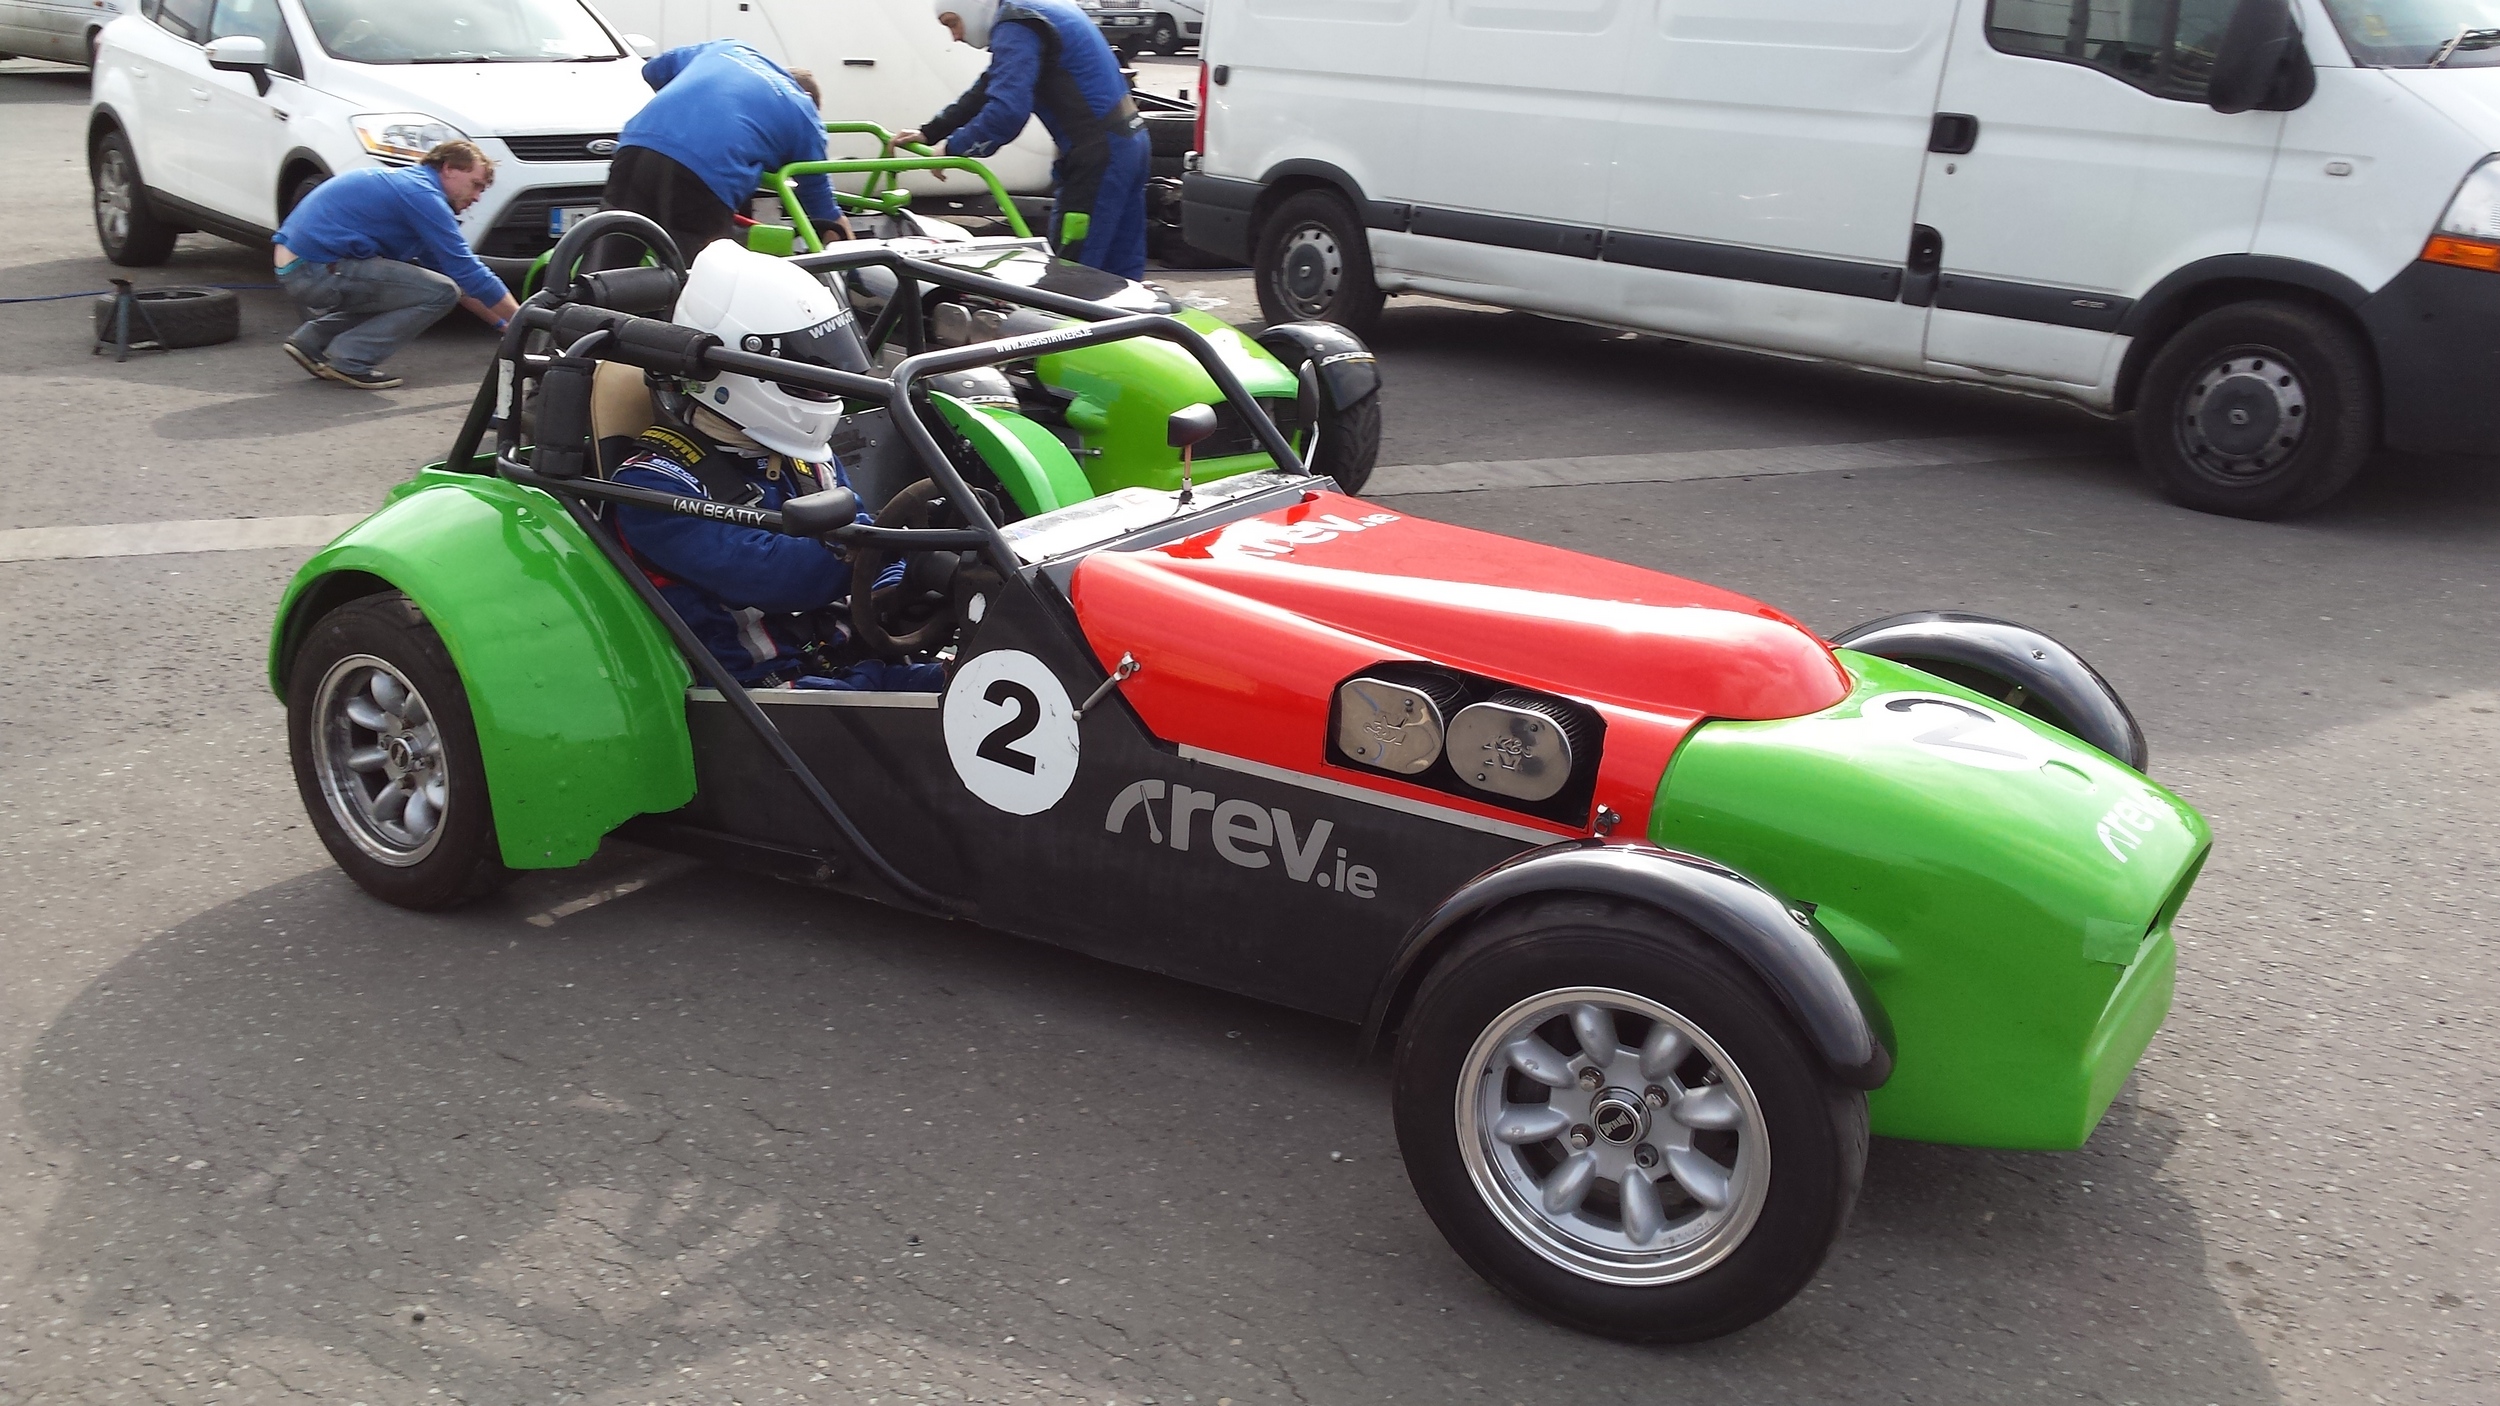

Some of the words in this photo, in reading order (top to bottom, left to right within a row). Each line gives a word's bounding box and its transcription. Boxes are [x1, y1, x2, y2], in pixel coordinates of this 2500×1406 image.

[673, 499, 700, 515] IAN
[703, 505, 766, 525] BEATTY
[976, 679, 1041, 776] 2
[1886, 698, 2028, 760] 2
[1169, 783, 1378, 899] rev.ie
